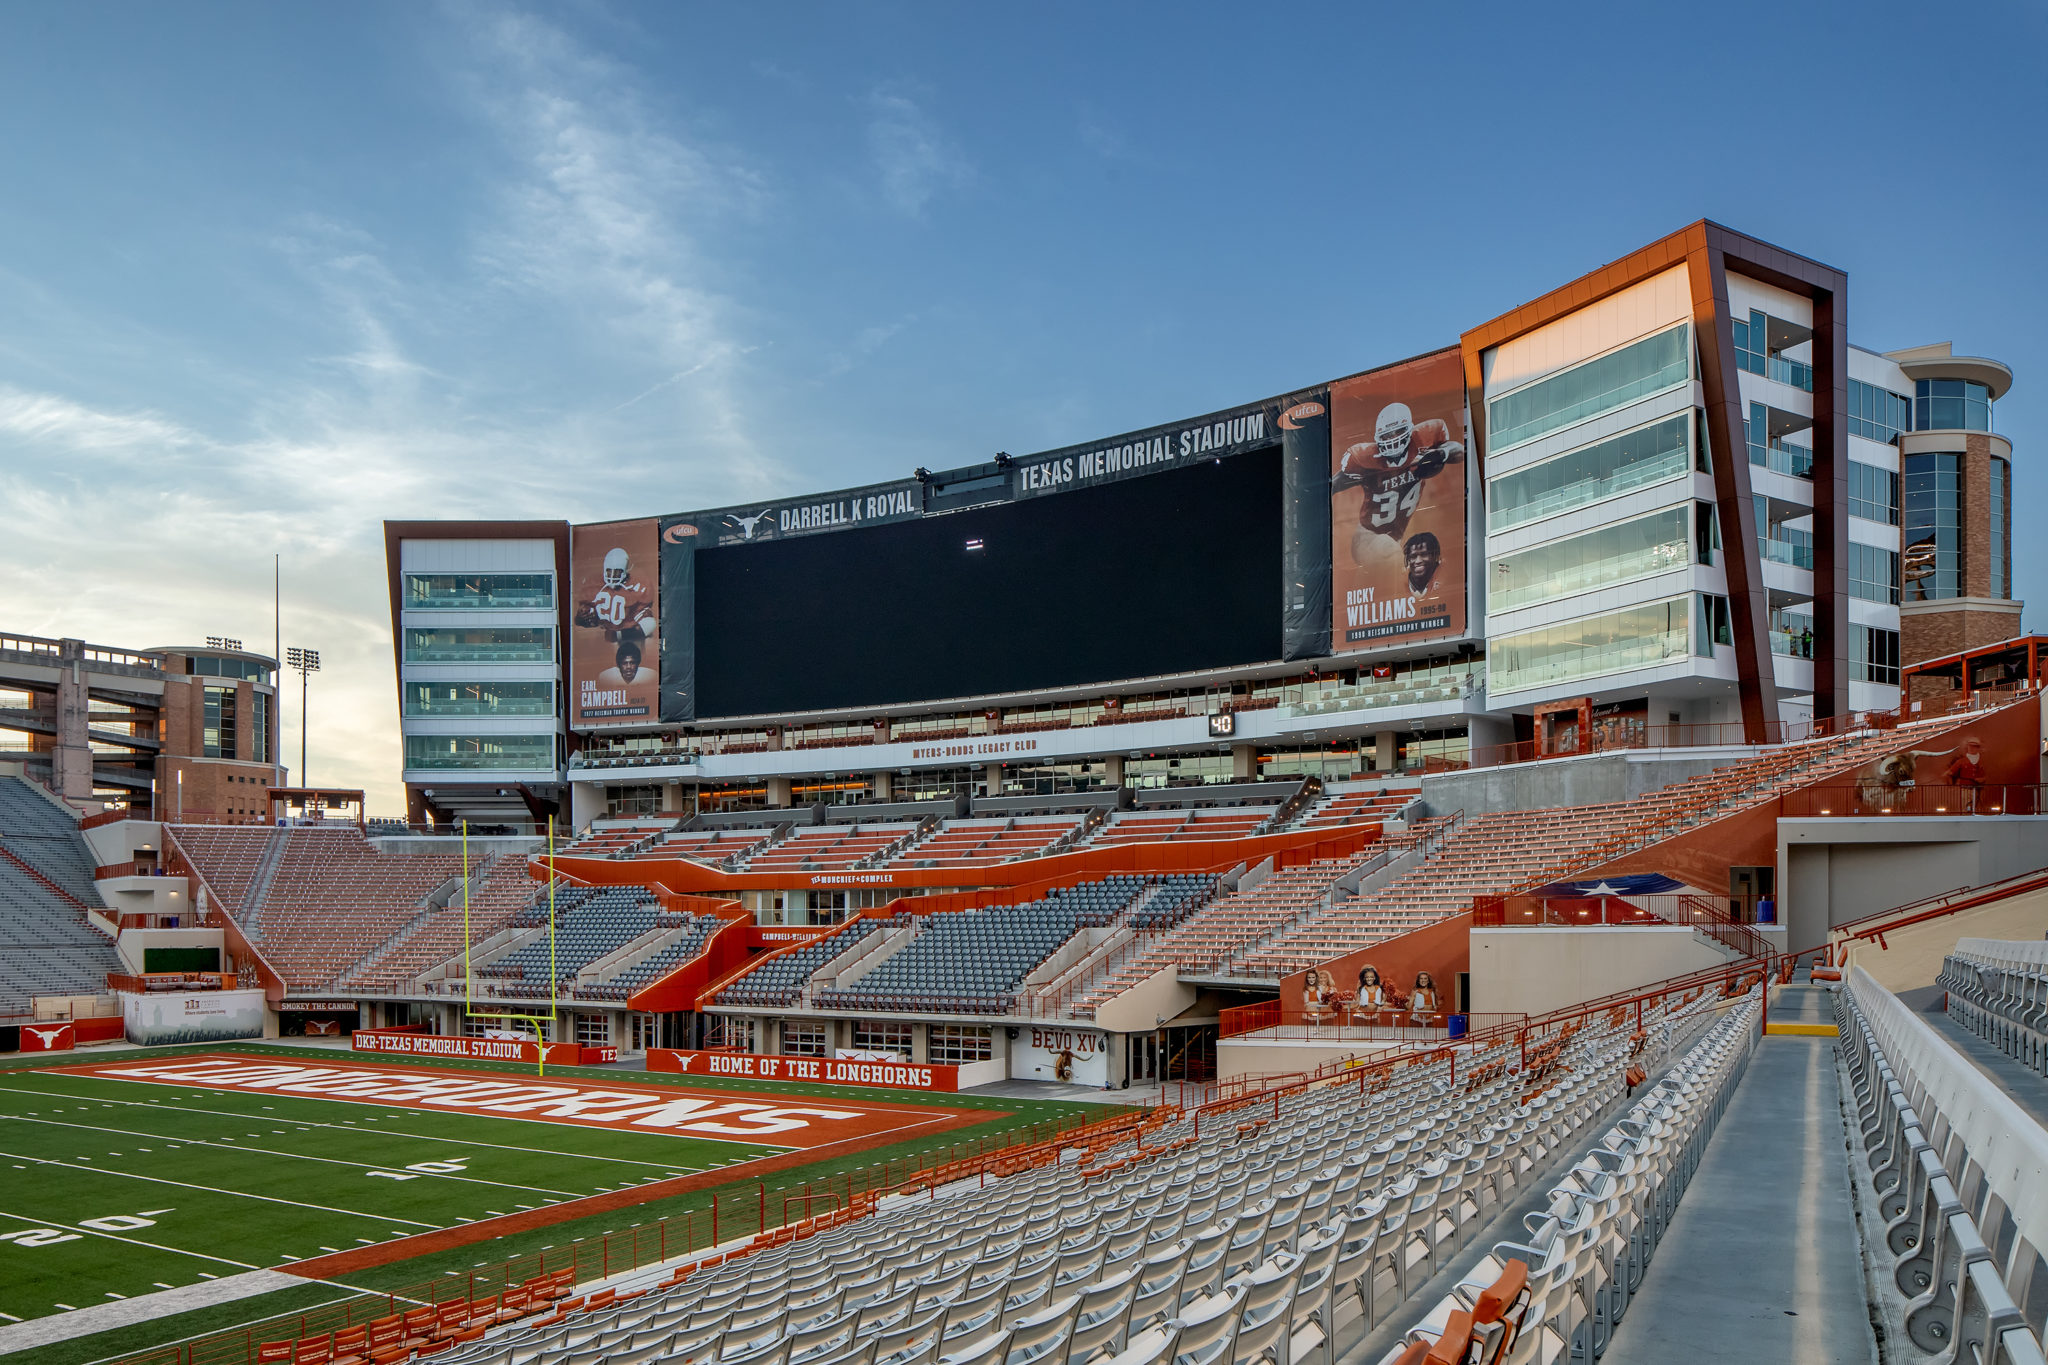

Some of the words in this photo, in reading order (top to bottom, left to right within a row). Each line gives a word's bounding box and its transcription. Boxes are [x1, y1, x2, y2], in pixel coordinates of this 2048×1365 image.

[1295, 404, 1318, 417] ufcu
[1020, 458, 1073, 491] TEXAS
[1079, 435, 1174, 479] MEMORIAL
[1180, 413, 1264, 457] STADIUM
[1382, 470, 1418, 492] TEXA
[780, 502, 848, 531] DARRELL
[852, 499, 862, 521] K
[867, 490, 915, 519] ROYAL
[1371, 480, 1422, 528] 34
[676, 527, 692, 535] ufcu
[1346, 587, 1375, 606] RICKY
[595, 591, 626, 626] 20
[1346, 596, 1416, 627] WILLIAMS
[1367, 626, 1394, 637] HEISMAN
[1396, 622, 1418, 633] TROPHY
[1421, 618, 1444, 629] WINNER
[581, 680, 597, 692] EARL
[581, 690, 628, 707] CAMPBELL
[1211, 715, 1232, 733] 40
[978, 741, 1011, 754] LEGACY
[1014, 740, 1037, 751] CLUB
[860, 874, 893, 883] COMPLEX
[281, 1002, 310, 1010] SMOKEY
[312, 1002, 326, 1010] THE
[327, 1002, 356, 1010] CANNON
[355, 1034, 411, 1052] DKR-TEXAS
[413, 1038, 469, 1056] MEMORIAL
[471, 1042, 522, 1059] STADIUM
[1031, 1031, 1072, 1050] BEVO
[1077, 1033, 1097, 1053] XV
[709, 1055, 754, 1075] HOME
[760, 1058, 780, 1076] OF
[785, 1060, 820, 1079] THE
[825, 1062, 932, 1087] LONGHORNS
[94, 1060, 866, 1135] LONGHORNS
[366, 1162, 468, 1181] 10
[0, 1215, 158, 1247] 20
